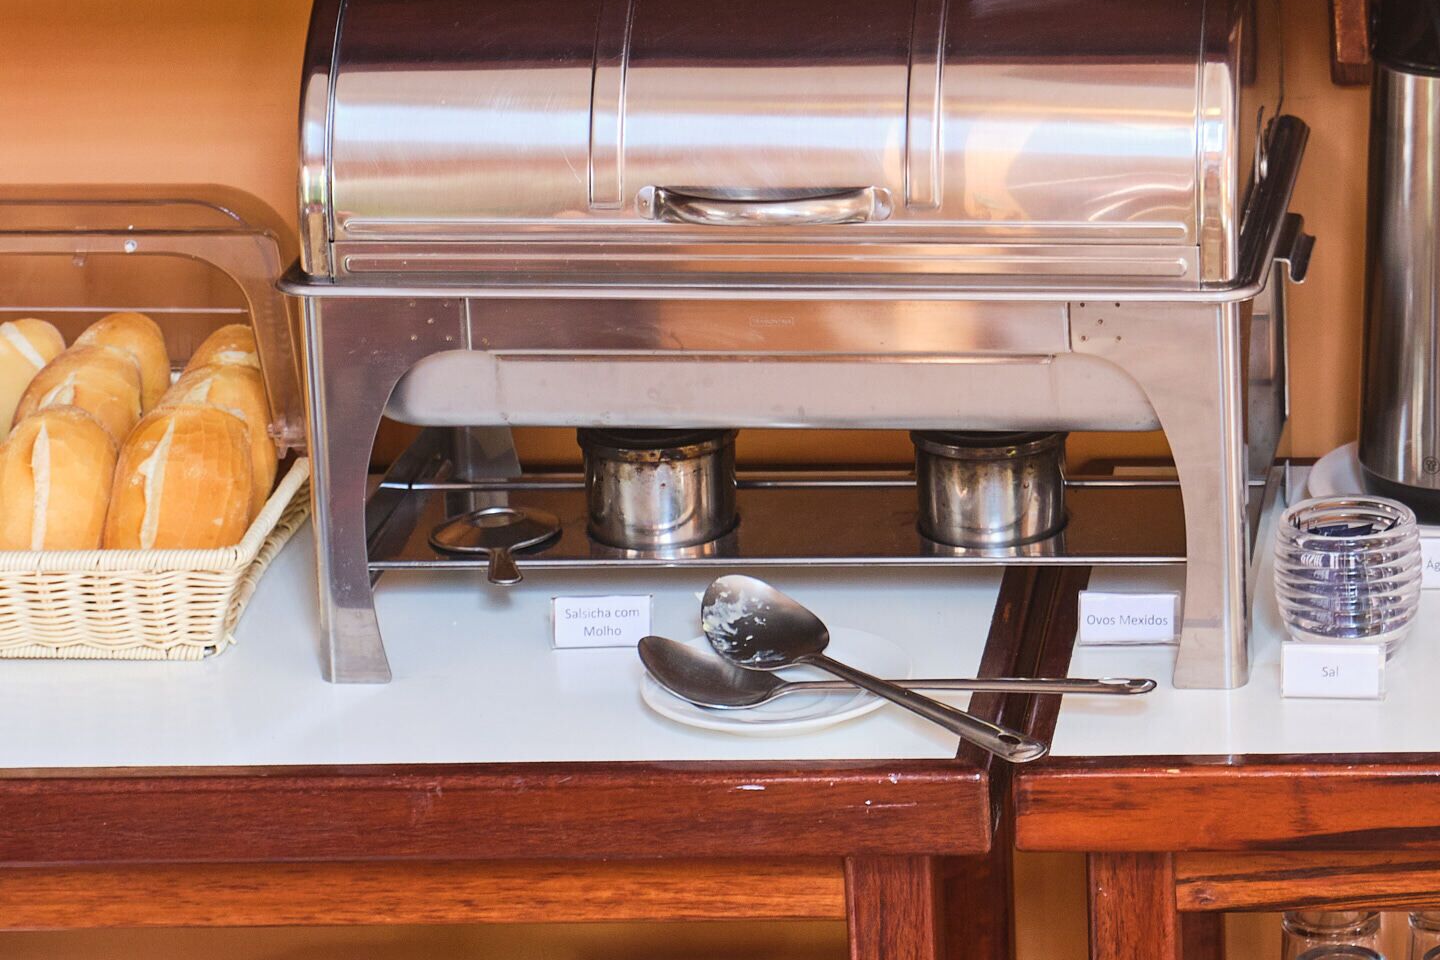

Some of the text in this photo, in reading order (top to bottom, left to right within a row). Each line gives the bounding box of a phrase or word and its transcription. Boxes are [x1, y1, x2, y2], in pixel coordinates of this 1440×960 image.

[565, 607, 640, 620] Salsicha com
[1086, 614, 1169, 626] Ovos Mexidos
[583, 625, 622, 637] Molho
[1321, 666, 1339, 678] Sal
